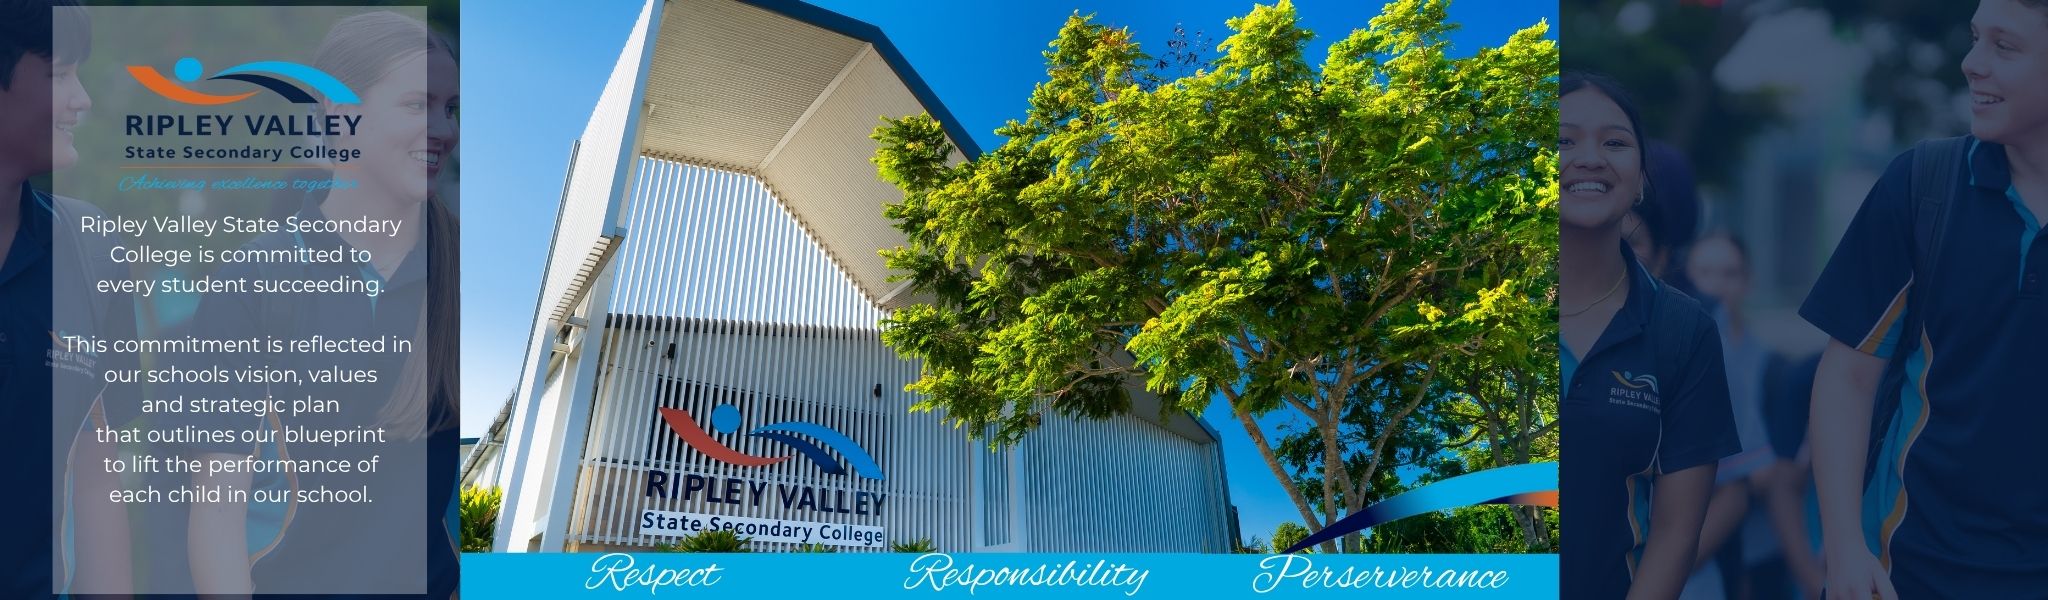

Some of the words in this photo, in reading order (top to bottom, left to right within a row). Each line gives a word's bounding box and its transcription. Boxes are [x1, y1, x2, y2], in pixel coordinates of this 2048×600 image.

[46, 349, 74, 362] RIPLEY
[1610, 387, 1641, 400] RIPLEY
[645, 470, 767, 506] RIPLEY
[779, 484, 886, 516] VALLEY
[641, 511, 702, 533] State
[709, 516, 813, 543] Secondary
[819, 524, 883, 546] College
